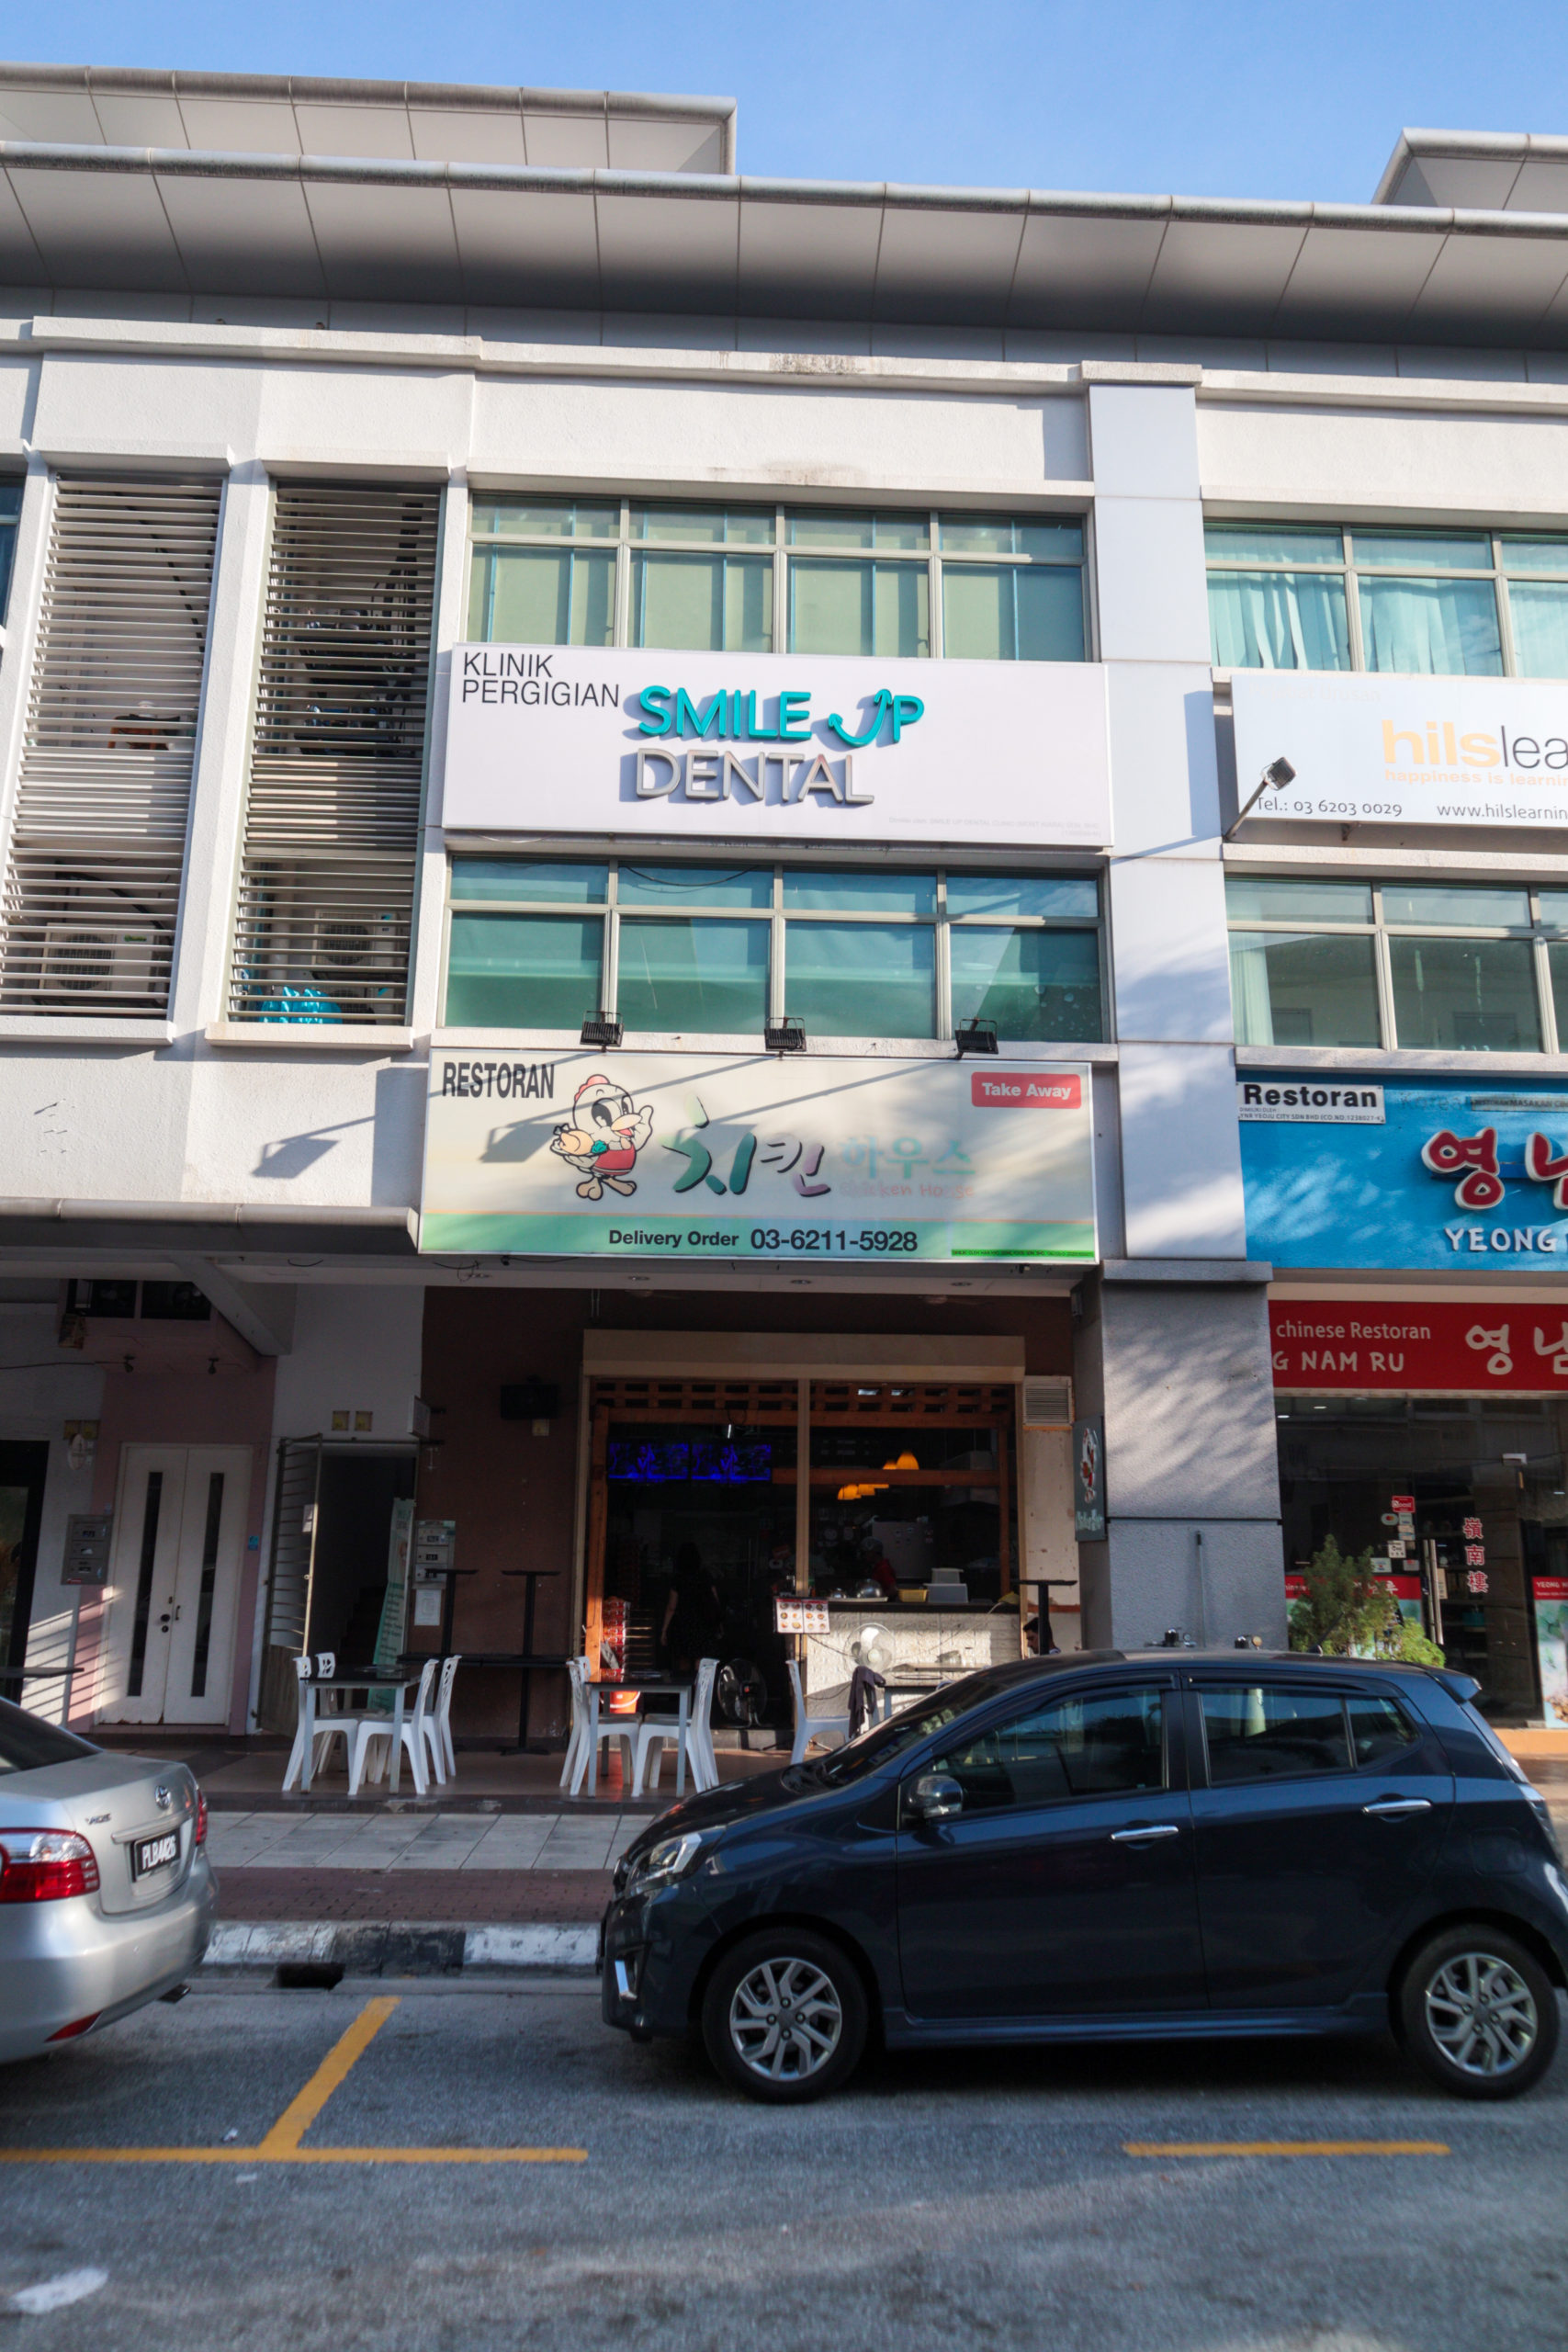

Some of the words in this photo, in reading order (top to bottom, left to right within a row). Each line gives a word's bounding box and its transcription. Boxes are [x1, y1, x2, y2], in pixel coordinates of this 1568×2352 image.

[464, 651, 554, 678] KLINIK
[462, 679, 619, 707] PERGIGIAN
[638, 685, 812, 741] SMILE
[636, 748, 874, 805] DENTAL
[1384, 768, 1482, 785] happiness
[1488, 772, 1504, 785] is
[1257, 797, 1288, 811] Tel.:
[1293, 801, 1314, 815] 03
[1318, 800, 1357, 816] 6203
[1362, 803, 1403, 817] 0029
[442, 1062, 555, 1099] RESTORAN
[981, 1082, 1021, 1098] Take
[1026, 1083, 1072, 1101] Away
[1244, 1084, 1377, 1108] Restoran
[838, 1136, 976, 1180] 하우스
[609, 1229, 682, 1249] Delivery
[687, 1231, 739, 1247] Order
[750, 1228, 918, 1251] 03-6211-5928
[1445, 1227, 1559, 1252] YEONG
[1276, 1319, 1345, 1338] chinese
[1350, 1321, 1431, 1340] Restoran
[1302, 1350, 1358, 1372] NAM
[1370, 1351, 1404, 1372] RU
